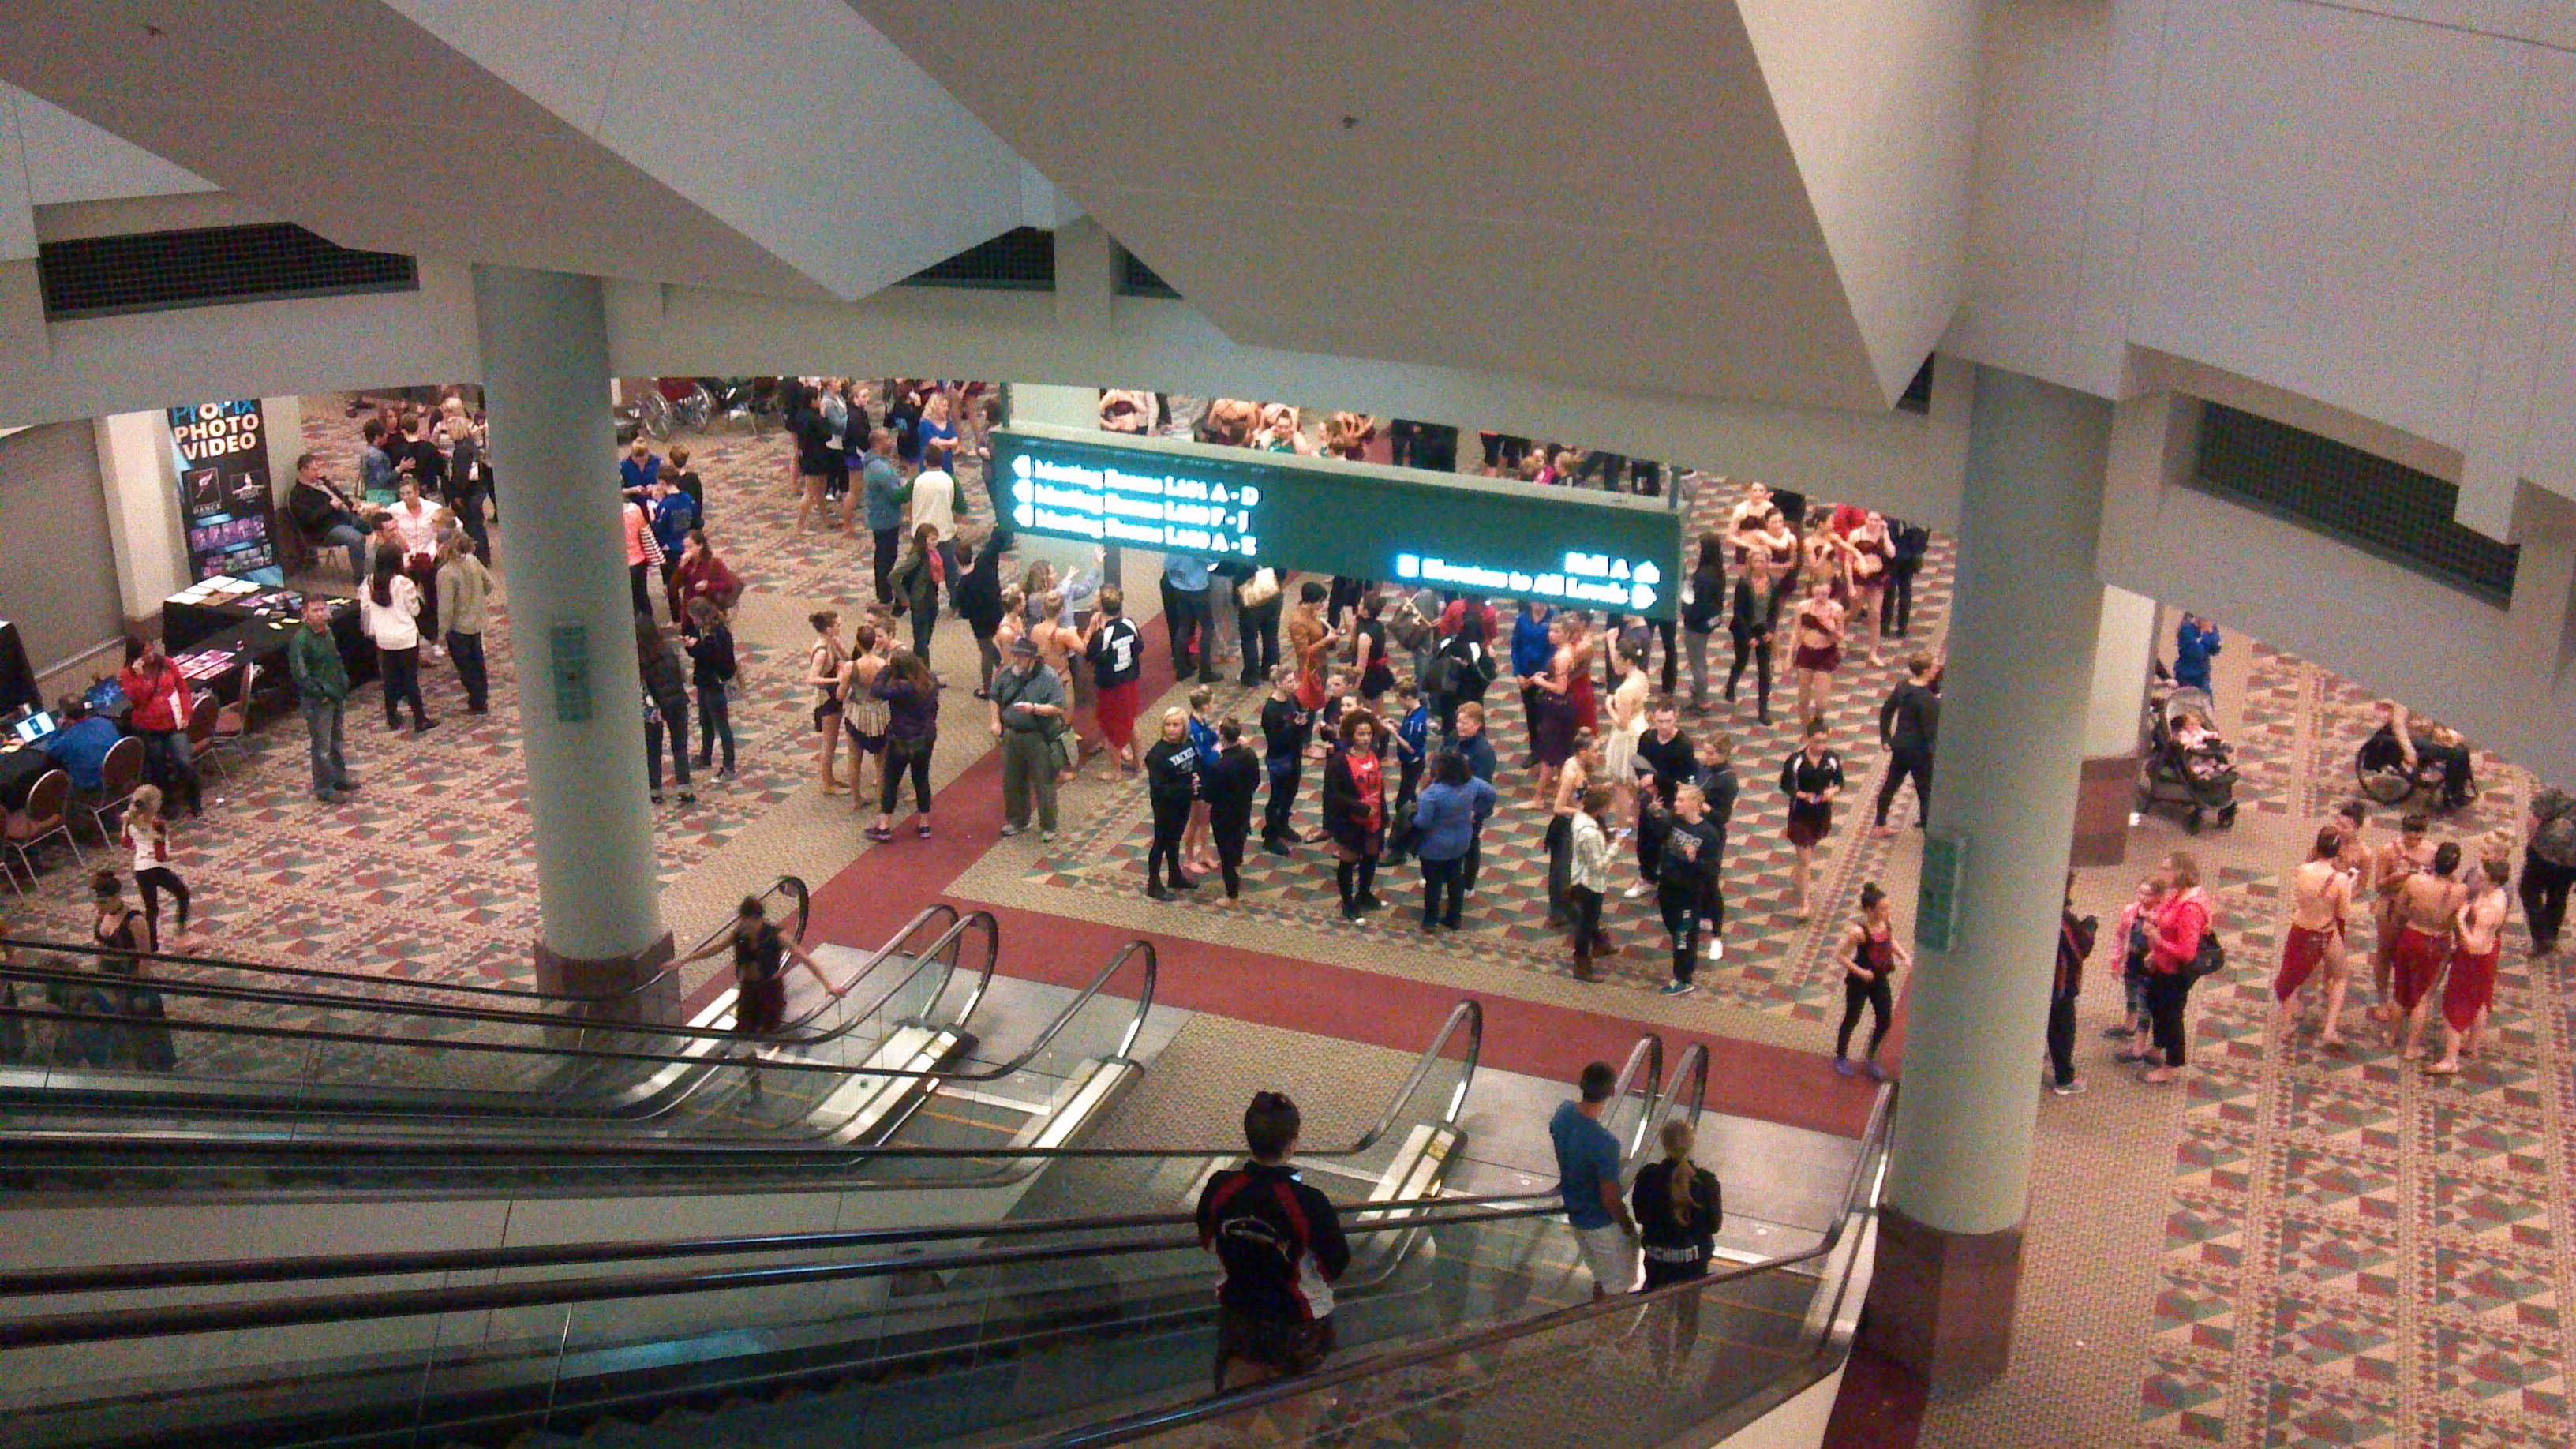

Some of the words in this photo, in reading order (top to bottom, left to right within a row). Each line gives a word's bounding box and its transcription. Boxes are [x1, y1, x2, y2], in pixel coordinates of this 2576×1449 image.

[174, 413, 260, 444] PHOTO
[182, 432, 256, 460] VIDEO
[1211, 484, 1229, 502] A
[1242, 487, 1259, 506] D
[1211, 534, 1229, 552] A
[1609, 559, 1631, 579] A
[1508, 572, 1533, 591] to
[1533, 575, 1565, 596] All
